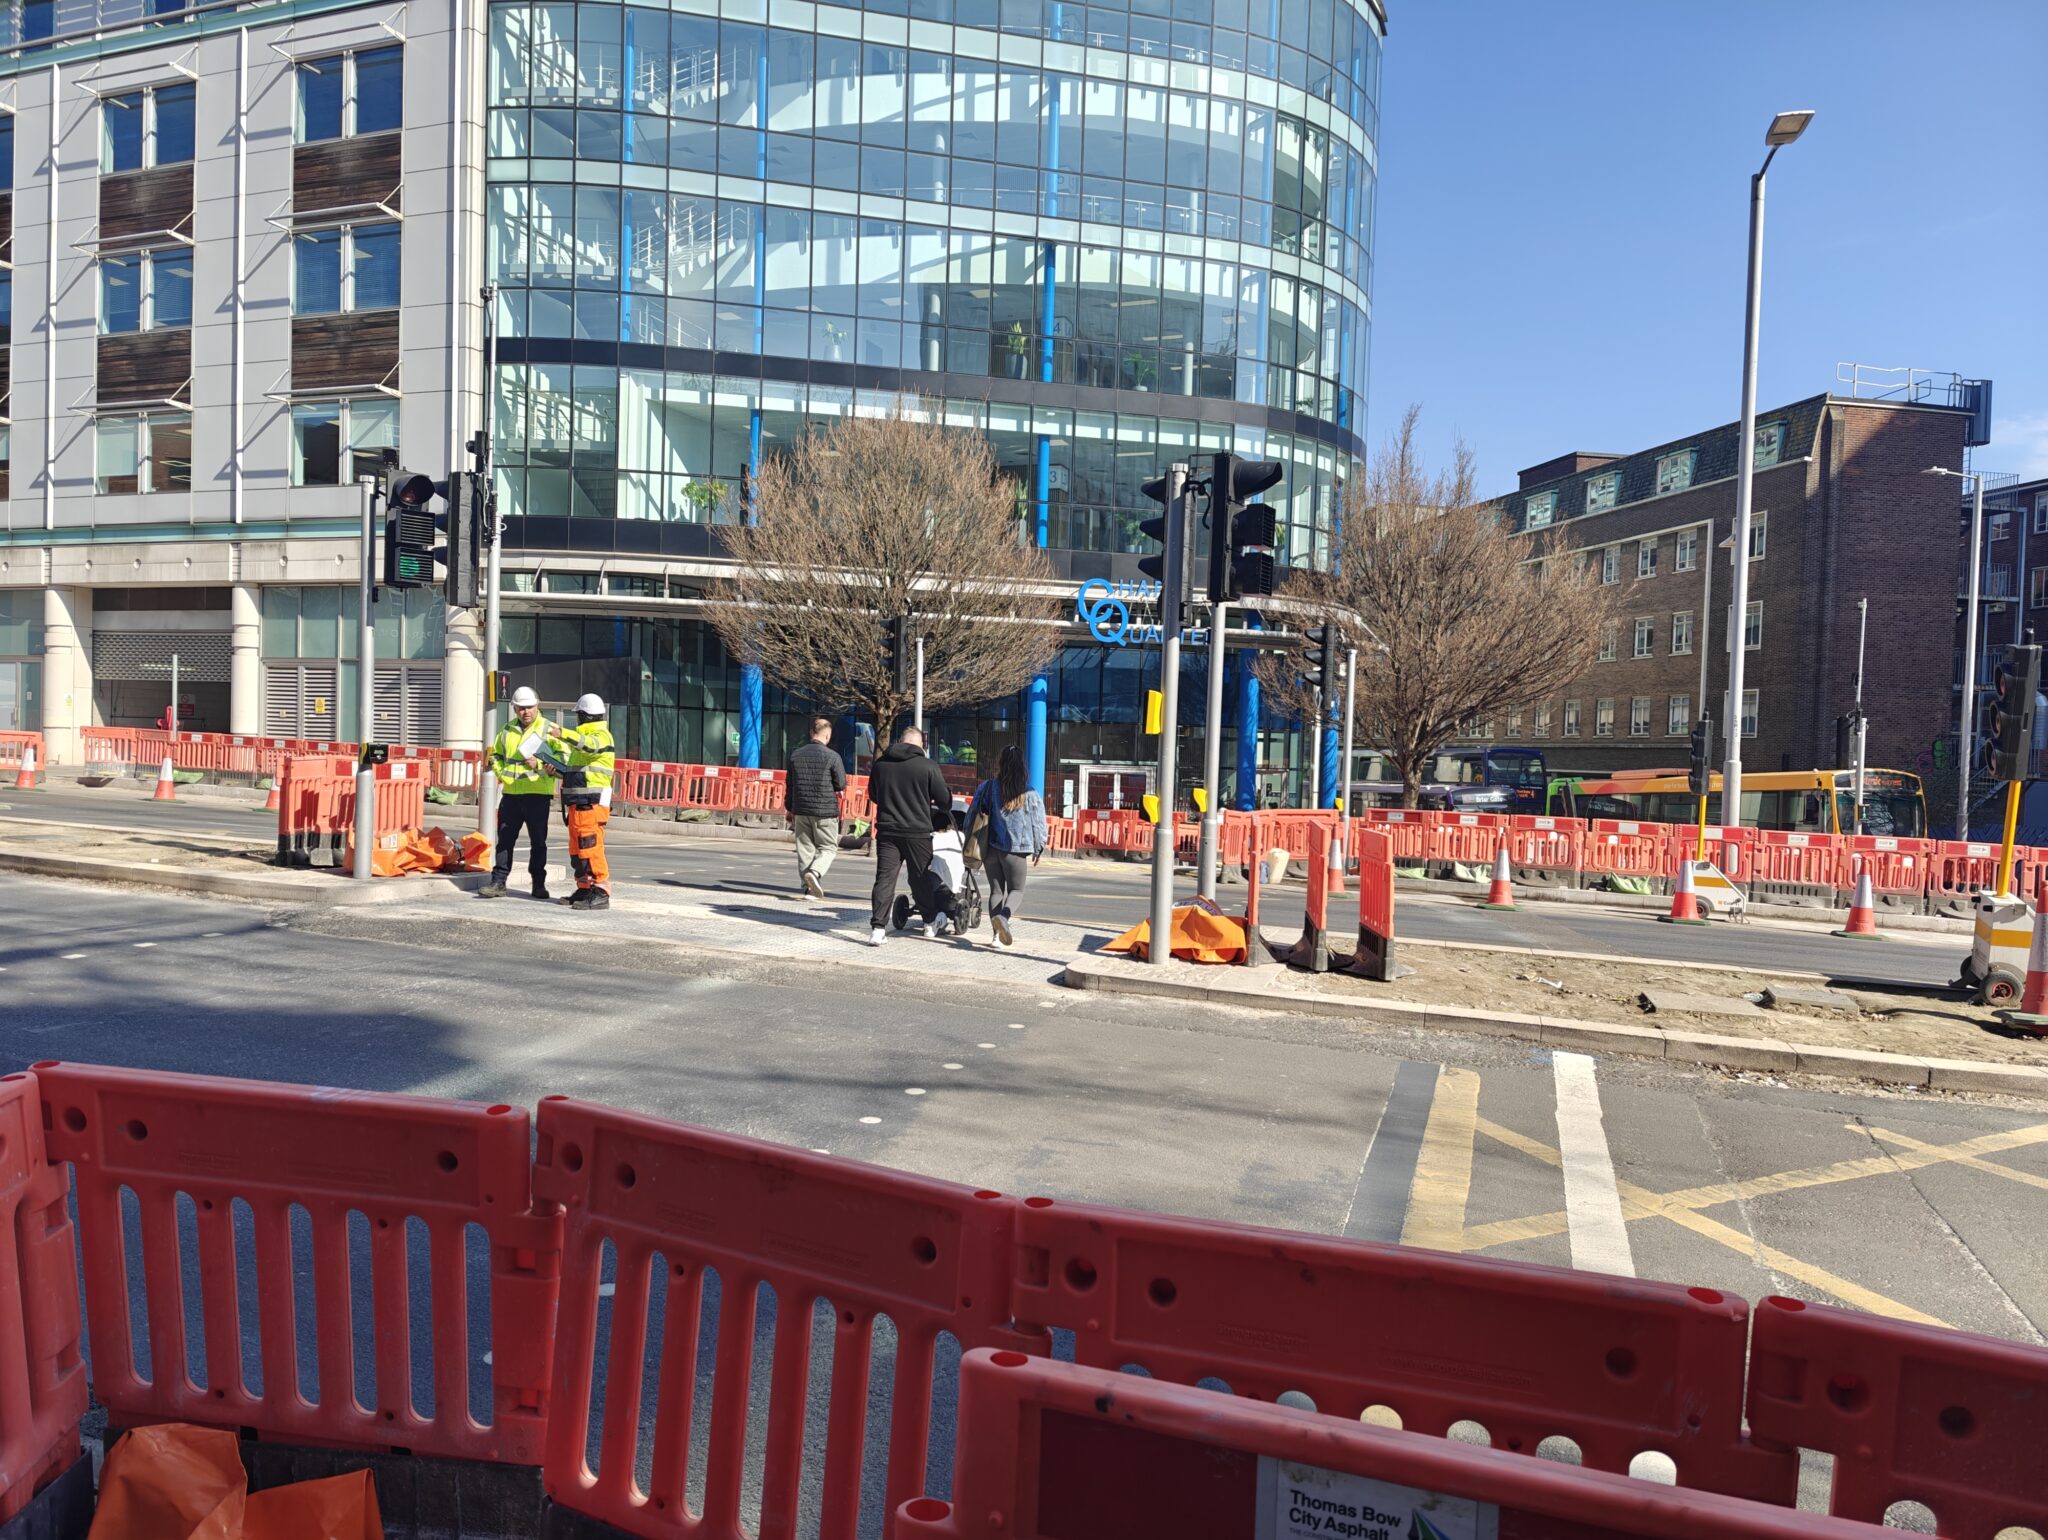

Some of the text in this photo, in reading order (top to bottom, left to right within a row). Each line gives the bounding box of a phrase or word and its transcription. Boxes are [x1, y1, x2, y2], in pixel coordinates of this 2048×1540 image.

[1050, 470, 1057, 483] 3
[1078, 578, 1164, 623] CHAP
[1289, 1507, 1390, 1540] City Asphalt
[1290, 1489, 1401, 1528] Thomas Bow
